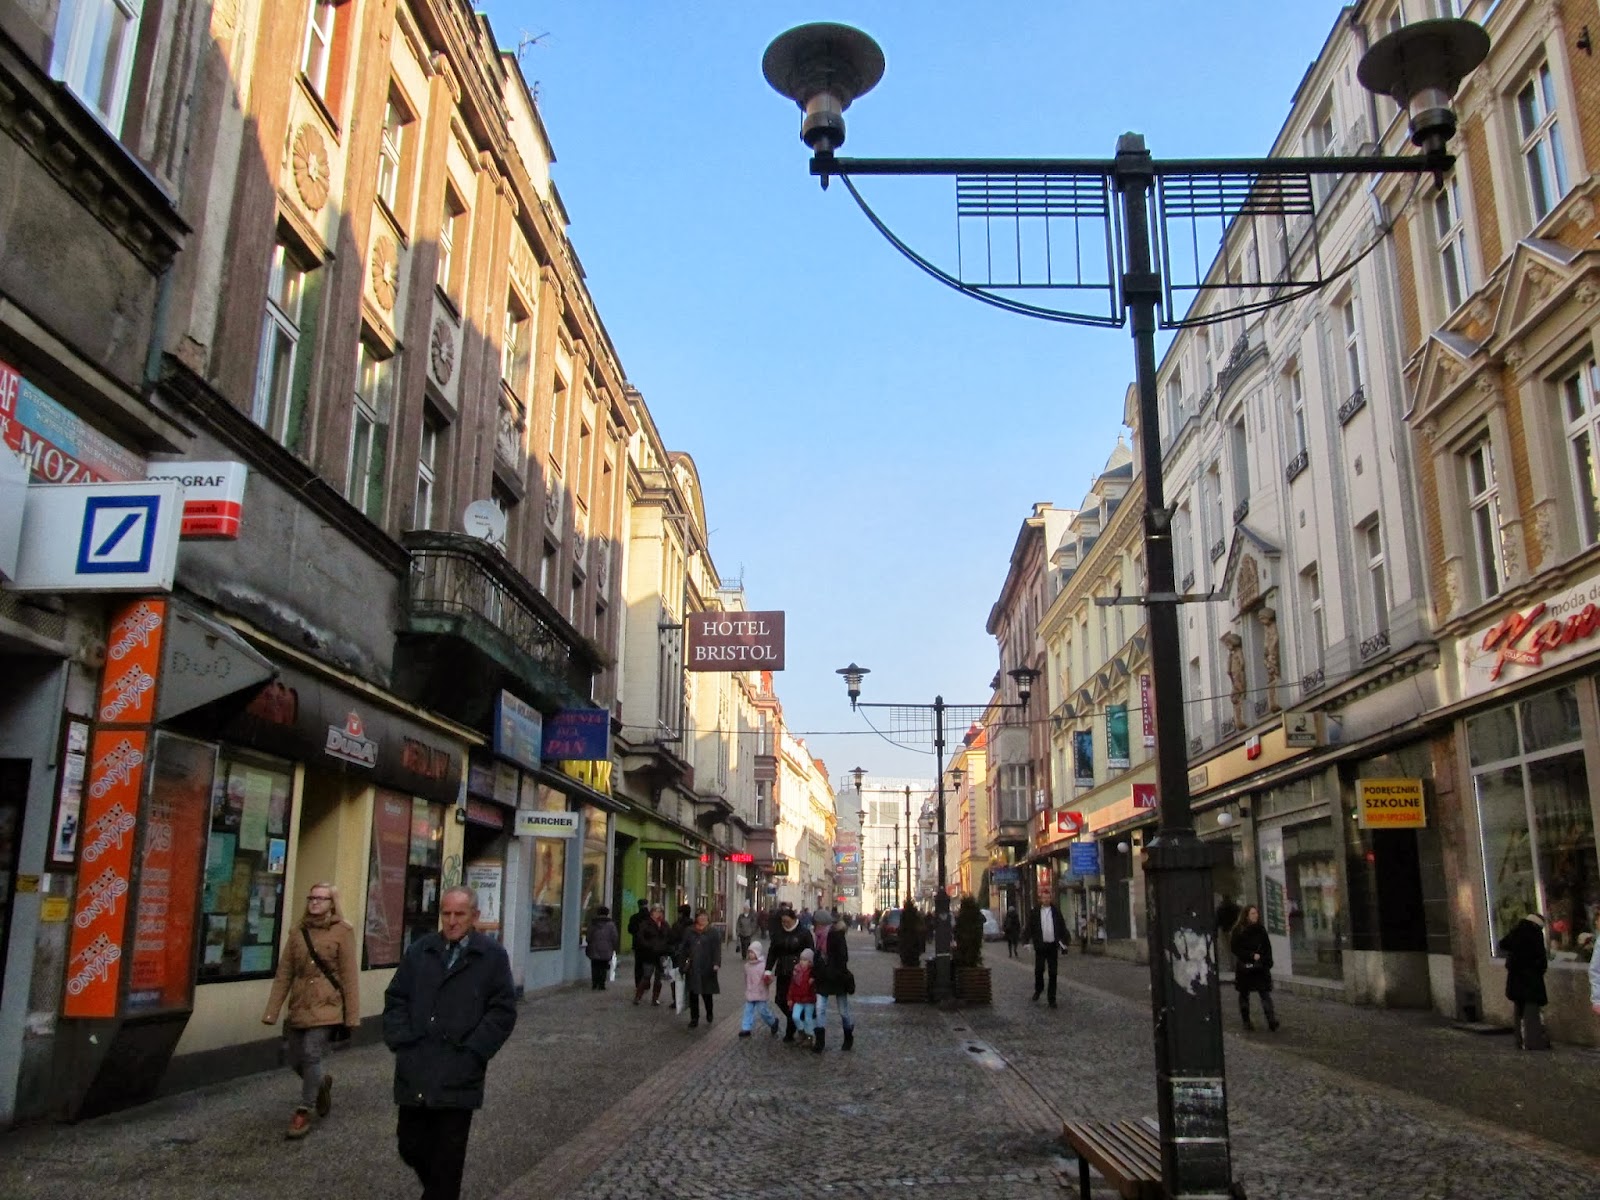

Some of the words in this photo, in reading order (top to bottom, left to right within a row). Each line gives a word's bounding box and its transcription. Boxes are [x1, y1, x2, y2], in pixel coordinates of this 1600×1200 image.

[702, 620, 771, 636] HOTEL
[1551, 593, 1586, 618] moda
[110, 612, 162, 660] ONYKS
[695, 645, 778, 660] BRISTOL
[101, 673, 154, 721] ONYKS
[91, 749, 144, 798] ONYKS
[1364, 785, 1419, 796] PODRĘCZNIKI
[1366, 798, 1421, 808] SZKOLNE
[82, 812, 136, 862] ONYKS
[75, 876, 129, 929] ONYKS
[67, 943, 122, 995] ONYKS
